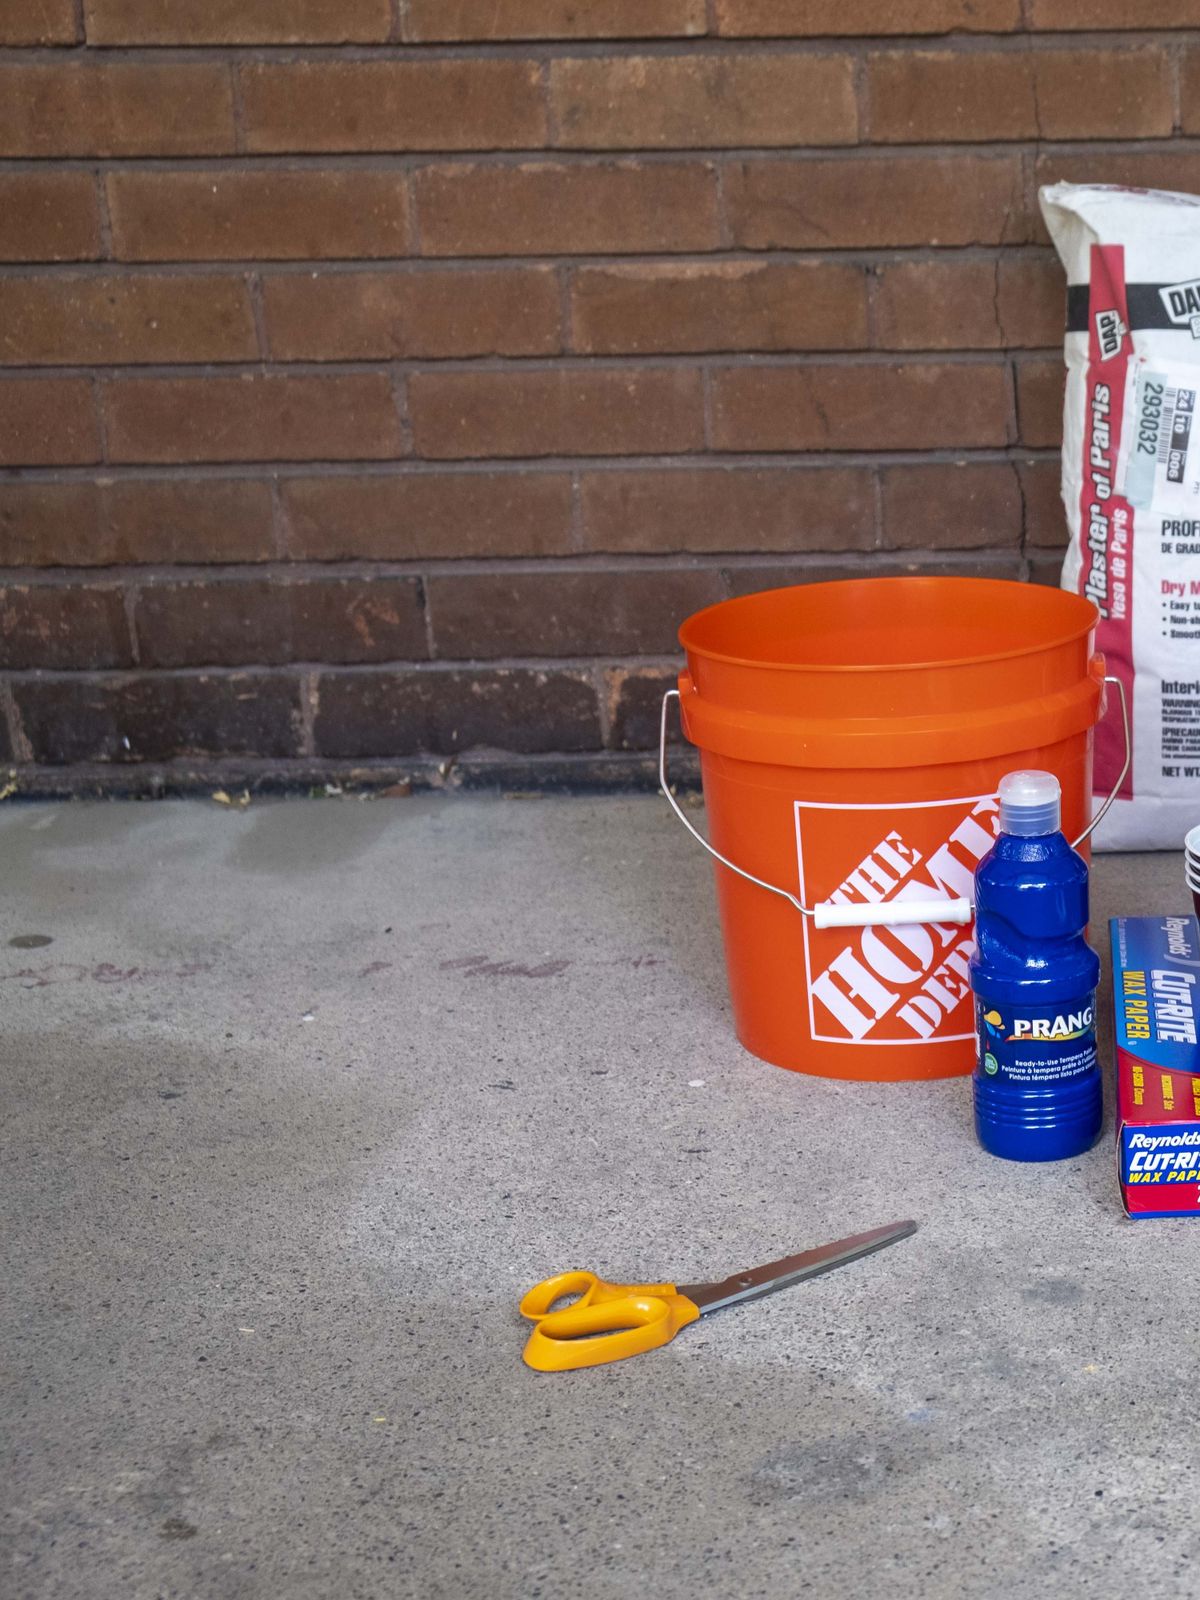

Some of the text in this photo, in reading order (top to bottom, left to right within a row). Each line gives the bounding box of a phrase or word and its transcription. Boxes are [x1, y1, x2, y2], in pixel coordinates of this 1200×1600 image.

[1100, 316, 1118, 354] DAP
[1178, 390, 1190, 409] 24
[1090, 384, 1111, 470] Paris
[1137, 382, 1164, 456] 293032
[1174, 414, 1186, 434] 10
[1168, 450, 1180, 478] 006
[1094, 476, 1111, 500] of
[1161, 542, 1173, 554] DE
[1110, 508, 1128, 620] Yeso de Paris
[1161, 580, 1186, 598] Dry
[1170, 601, 1190, 612] Easy
[1162, 766, 1181, 777] NET
[823, 830, 923, 905] THE
[1161, 917, 1191, 958] Reynolds
[1122, 970, 1147, 996] WAX
[1124, 1000, 1150, 1040] PAPER
[1151, 970, 1198, 1045] CUT-RITE
[1014, 1007, 1092, 1038] PRANG
[1002, 1065, 1026, 1074] Peinture
[1034, 1066, 1061, 1074] tempera
[1015, 1060, 1058, 1068] Ready-to-Use
[1060, 1053, 1083, 1064] Tempera
[1128, 1172, 1163, 1184] WAX
